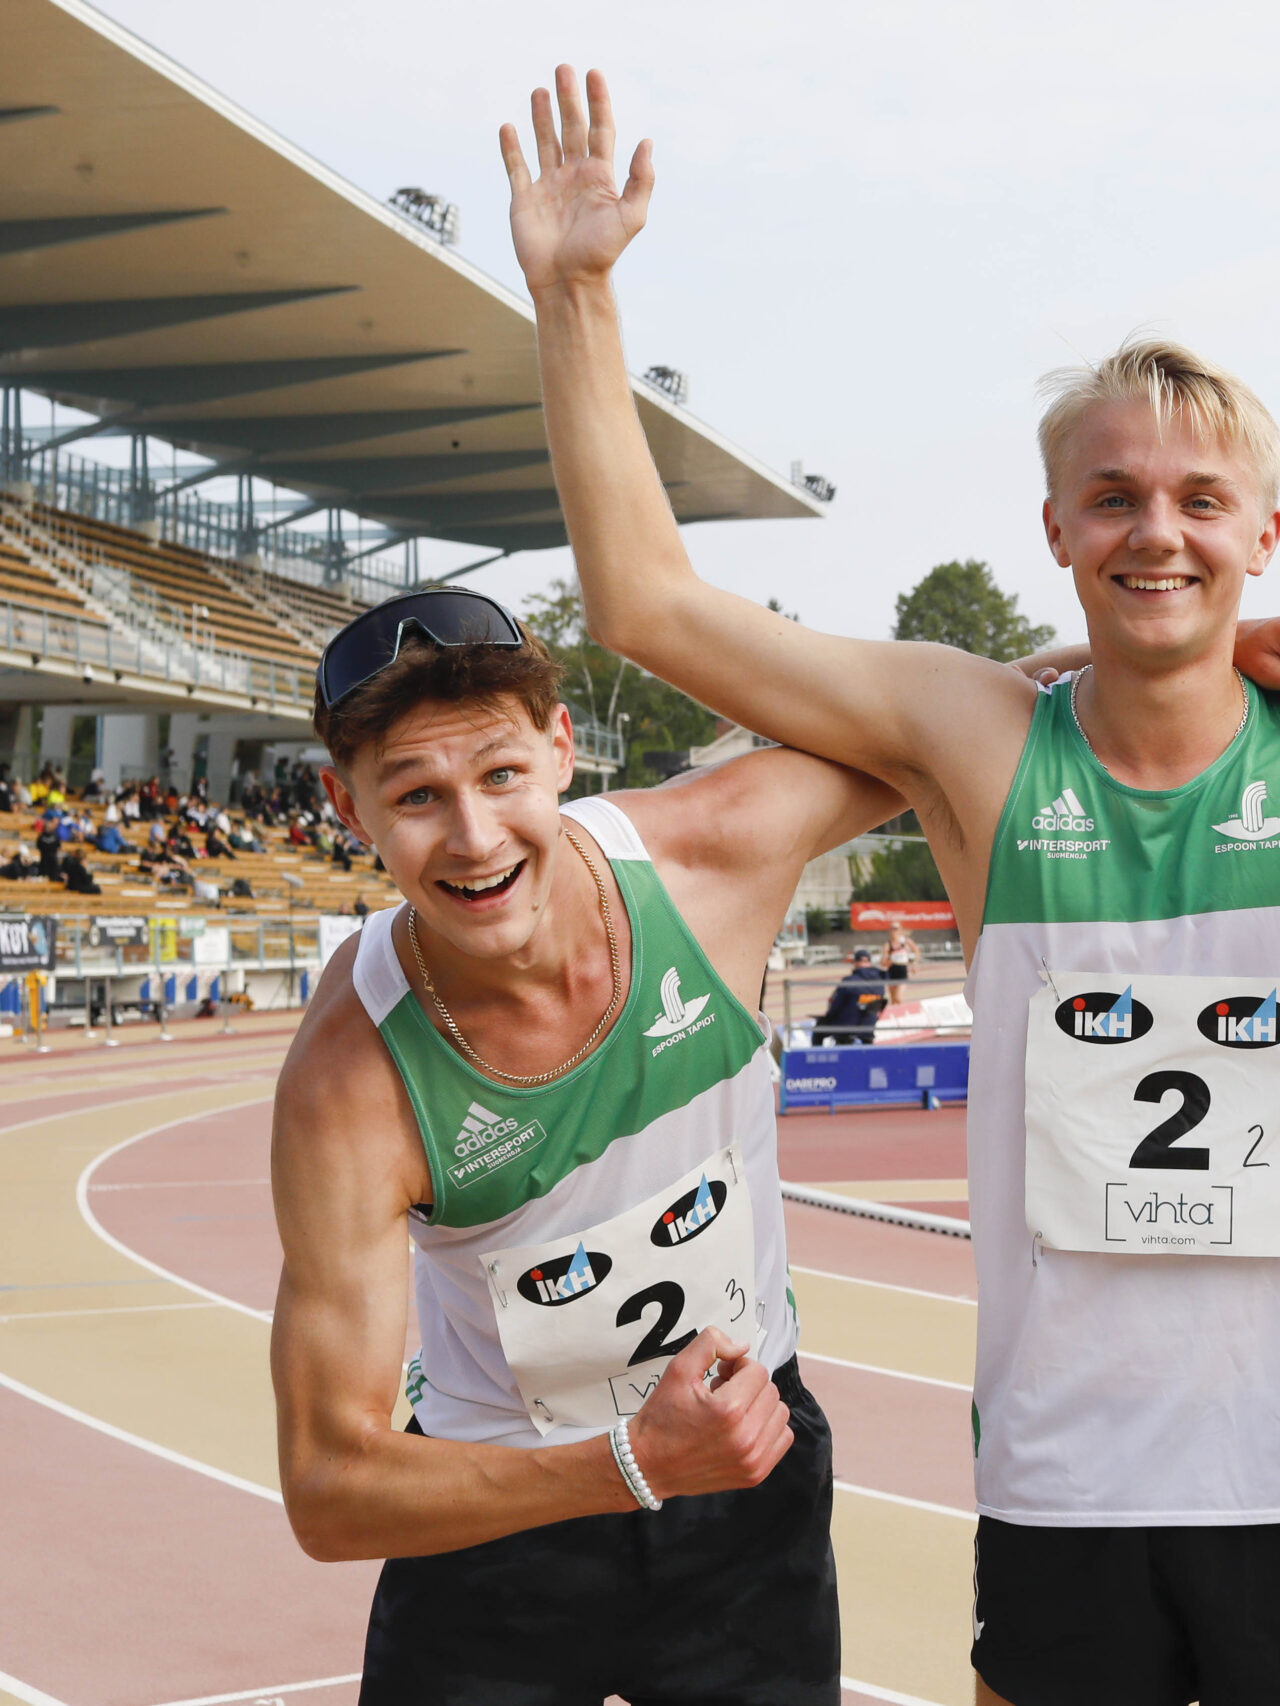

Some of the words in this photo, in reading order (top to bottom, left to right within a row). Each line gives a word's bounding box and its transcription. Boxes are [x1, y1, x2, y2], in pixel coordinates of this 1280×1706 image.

[1031, 814, 1095, 832] adidas
[1029, 839, 1108, 852] INTERSPORT
[1214, 842, 1257, 853] ESPOON
[652, 1032, 686, 1057] ESPOON
[686, 1013, 715, 1035] TAPIOT
[454, 1117, 519, 1157] adidas
[1129, 1070, 1211, 1170] 2
[464, 1126, 537, 1174] INTERSPORT
[1243, 1124, 1271, 1168] 2
[1123, 1192, 1214, 1226] vihta
[1141, 1234, 1196, 1246] vihta.com
[725, 1278, 746, 1323] 3
[616, 1280, 699, 1367] 2
